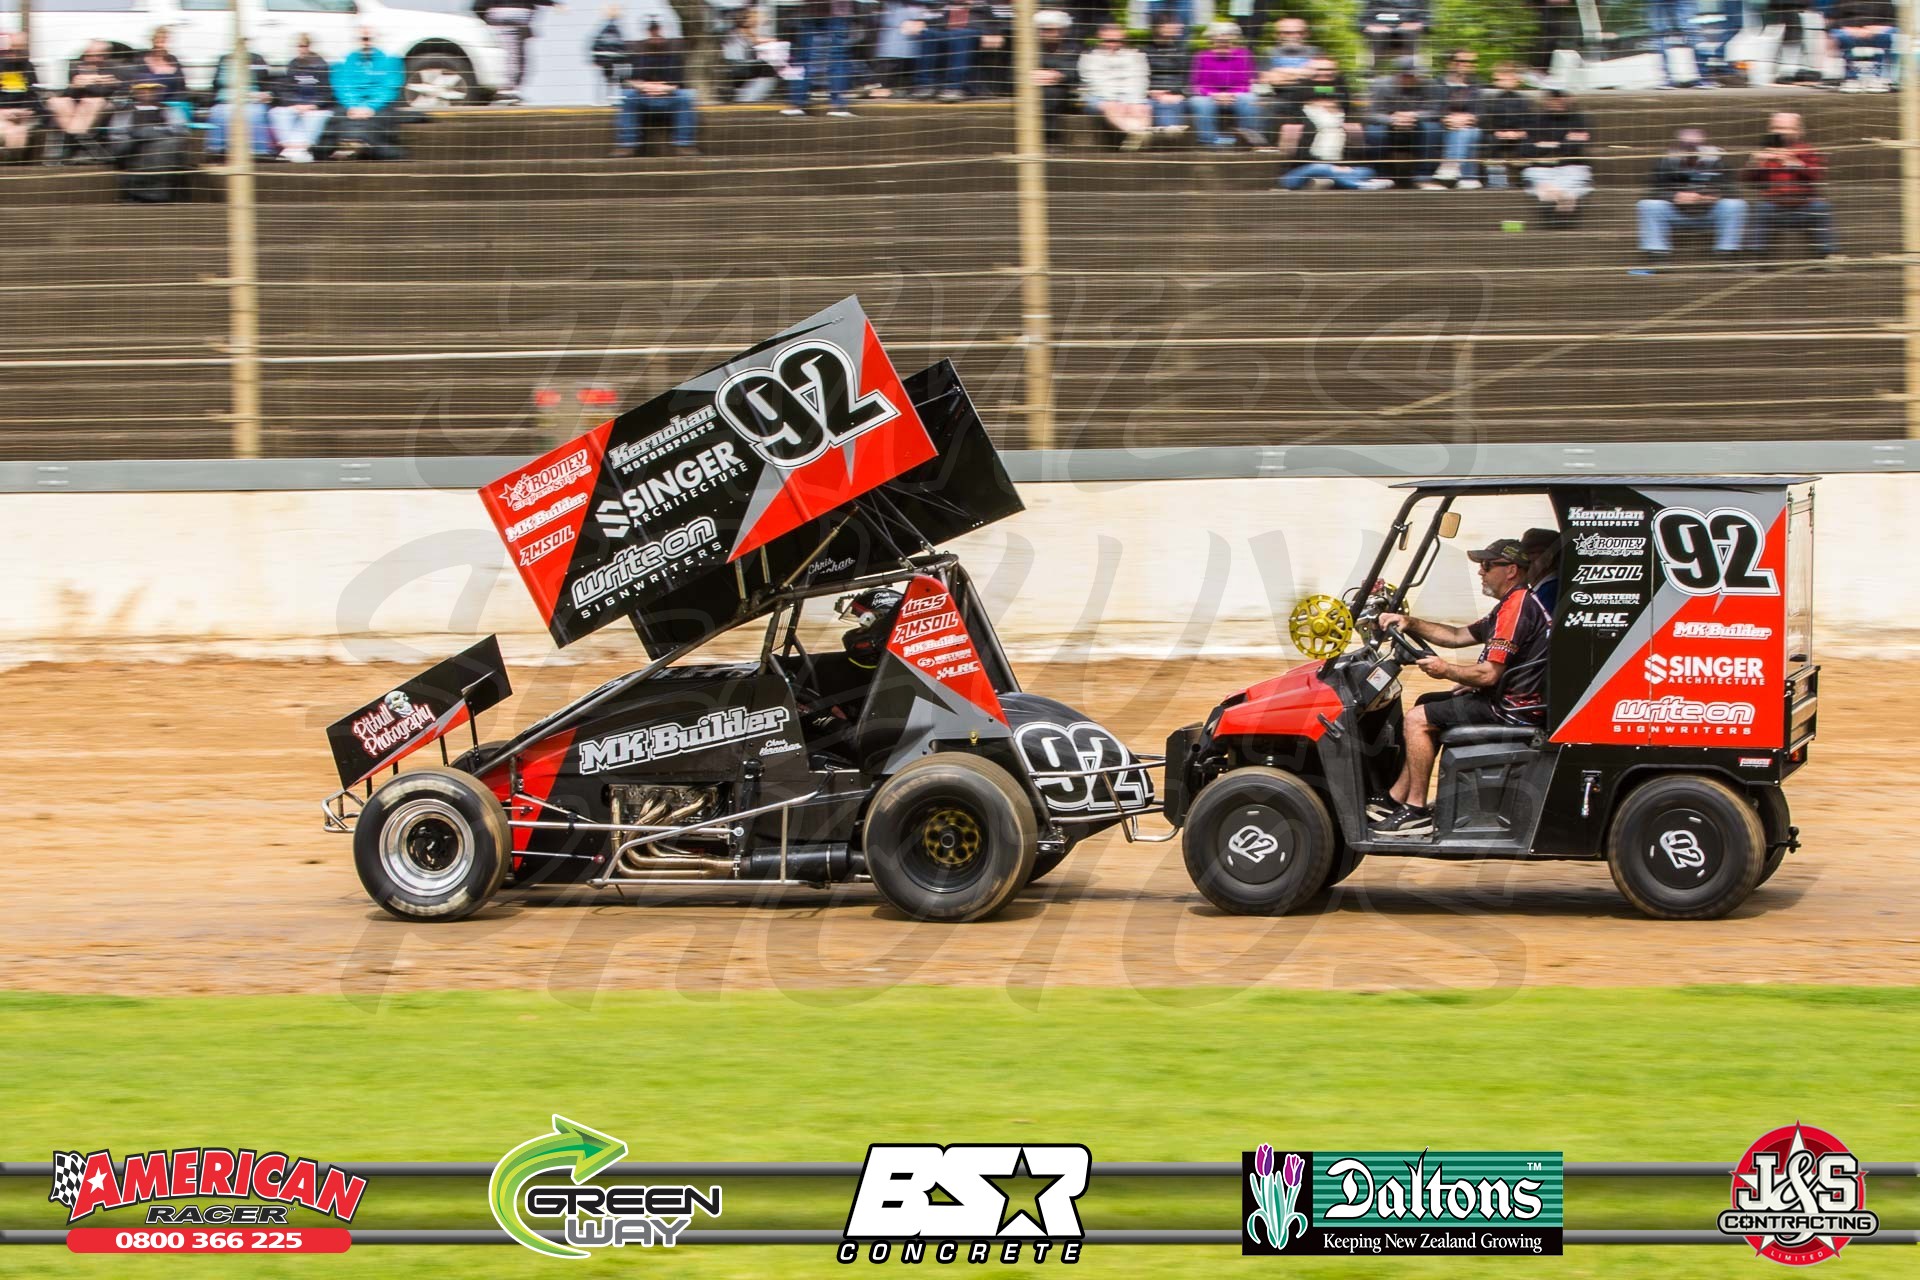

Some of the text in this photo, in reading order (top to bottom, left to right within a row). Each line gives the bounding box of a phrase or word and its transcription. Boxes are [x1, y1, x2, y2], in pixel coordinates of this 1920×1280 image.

[715, 339, 901, 469] 92
[608, 405, 717, 469] Kernohan
[621, 422, 715, 474] MOTORSPORTS
[528, 450, 587, 494] RODNEY
[623, 441, 743, 517] SINGER
[634, 463, 748, 527] ARCHITECTURE
[1568, 507, 1644, 520] Kernohan
[520, 525, 575, 566] AMSOIL
[1598, 537, 1646, 550] RODNEY
[1652, 506, 1781, 596] 92
[581, 542, 721, 618] SIGNWRITERS
[1572, 565, 1644, 584] AMSOIL
[892, 611, 958, 644] AMSOIL
[1583, 612, 1629, 623] LRC
[1673, 622, 1772, 640] MK Builder
[1668, 677, 1765, 686] ARCHITECTURE
[1669, 656, 1763, 679] SINGER
[353, 703, 396, 740] Pitbull
[363, 704, 436, 756] Photography
[579, 706, 790, 775] MK Builder
[1613, 725, 1752, 735] SIGNWRITERS
[1014, 722, 1145, 811] 92
[1228, 825, 1278, 863] 92
